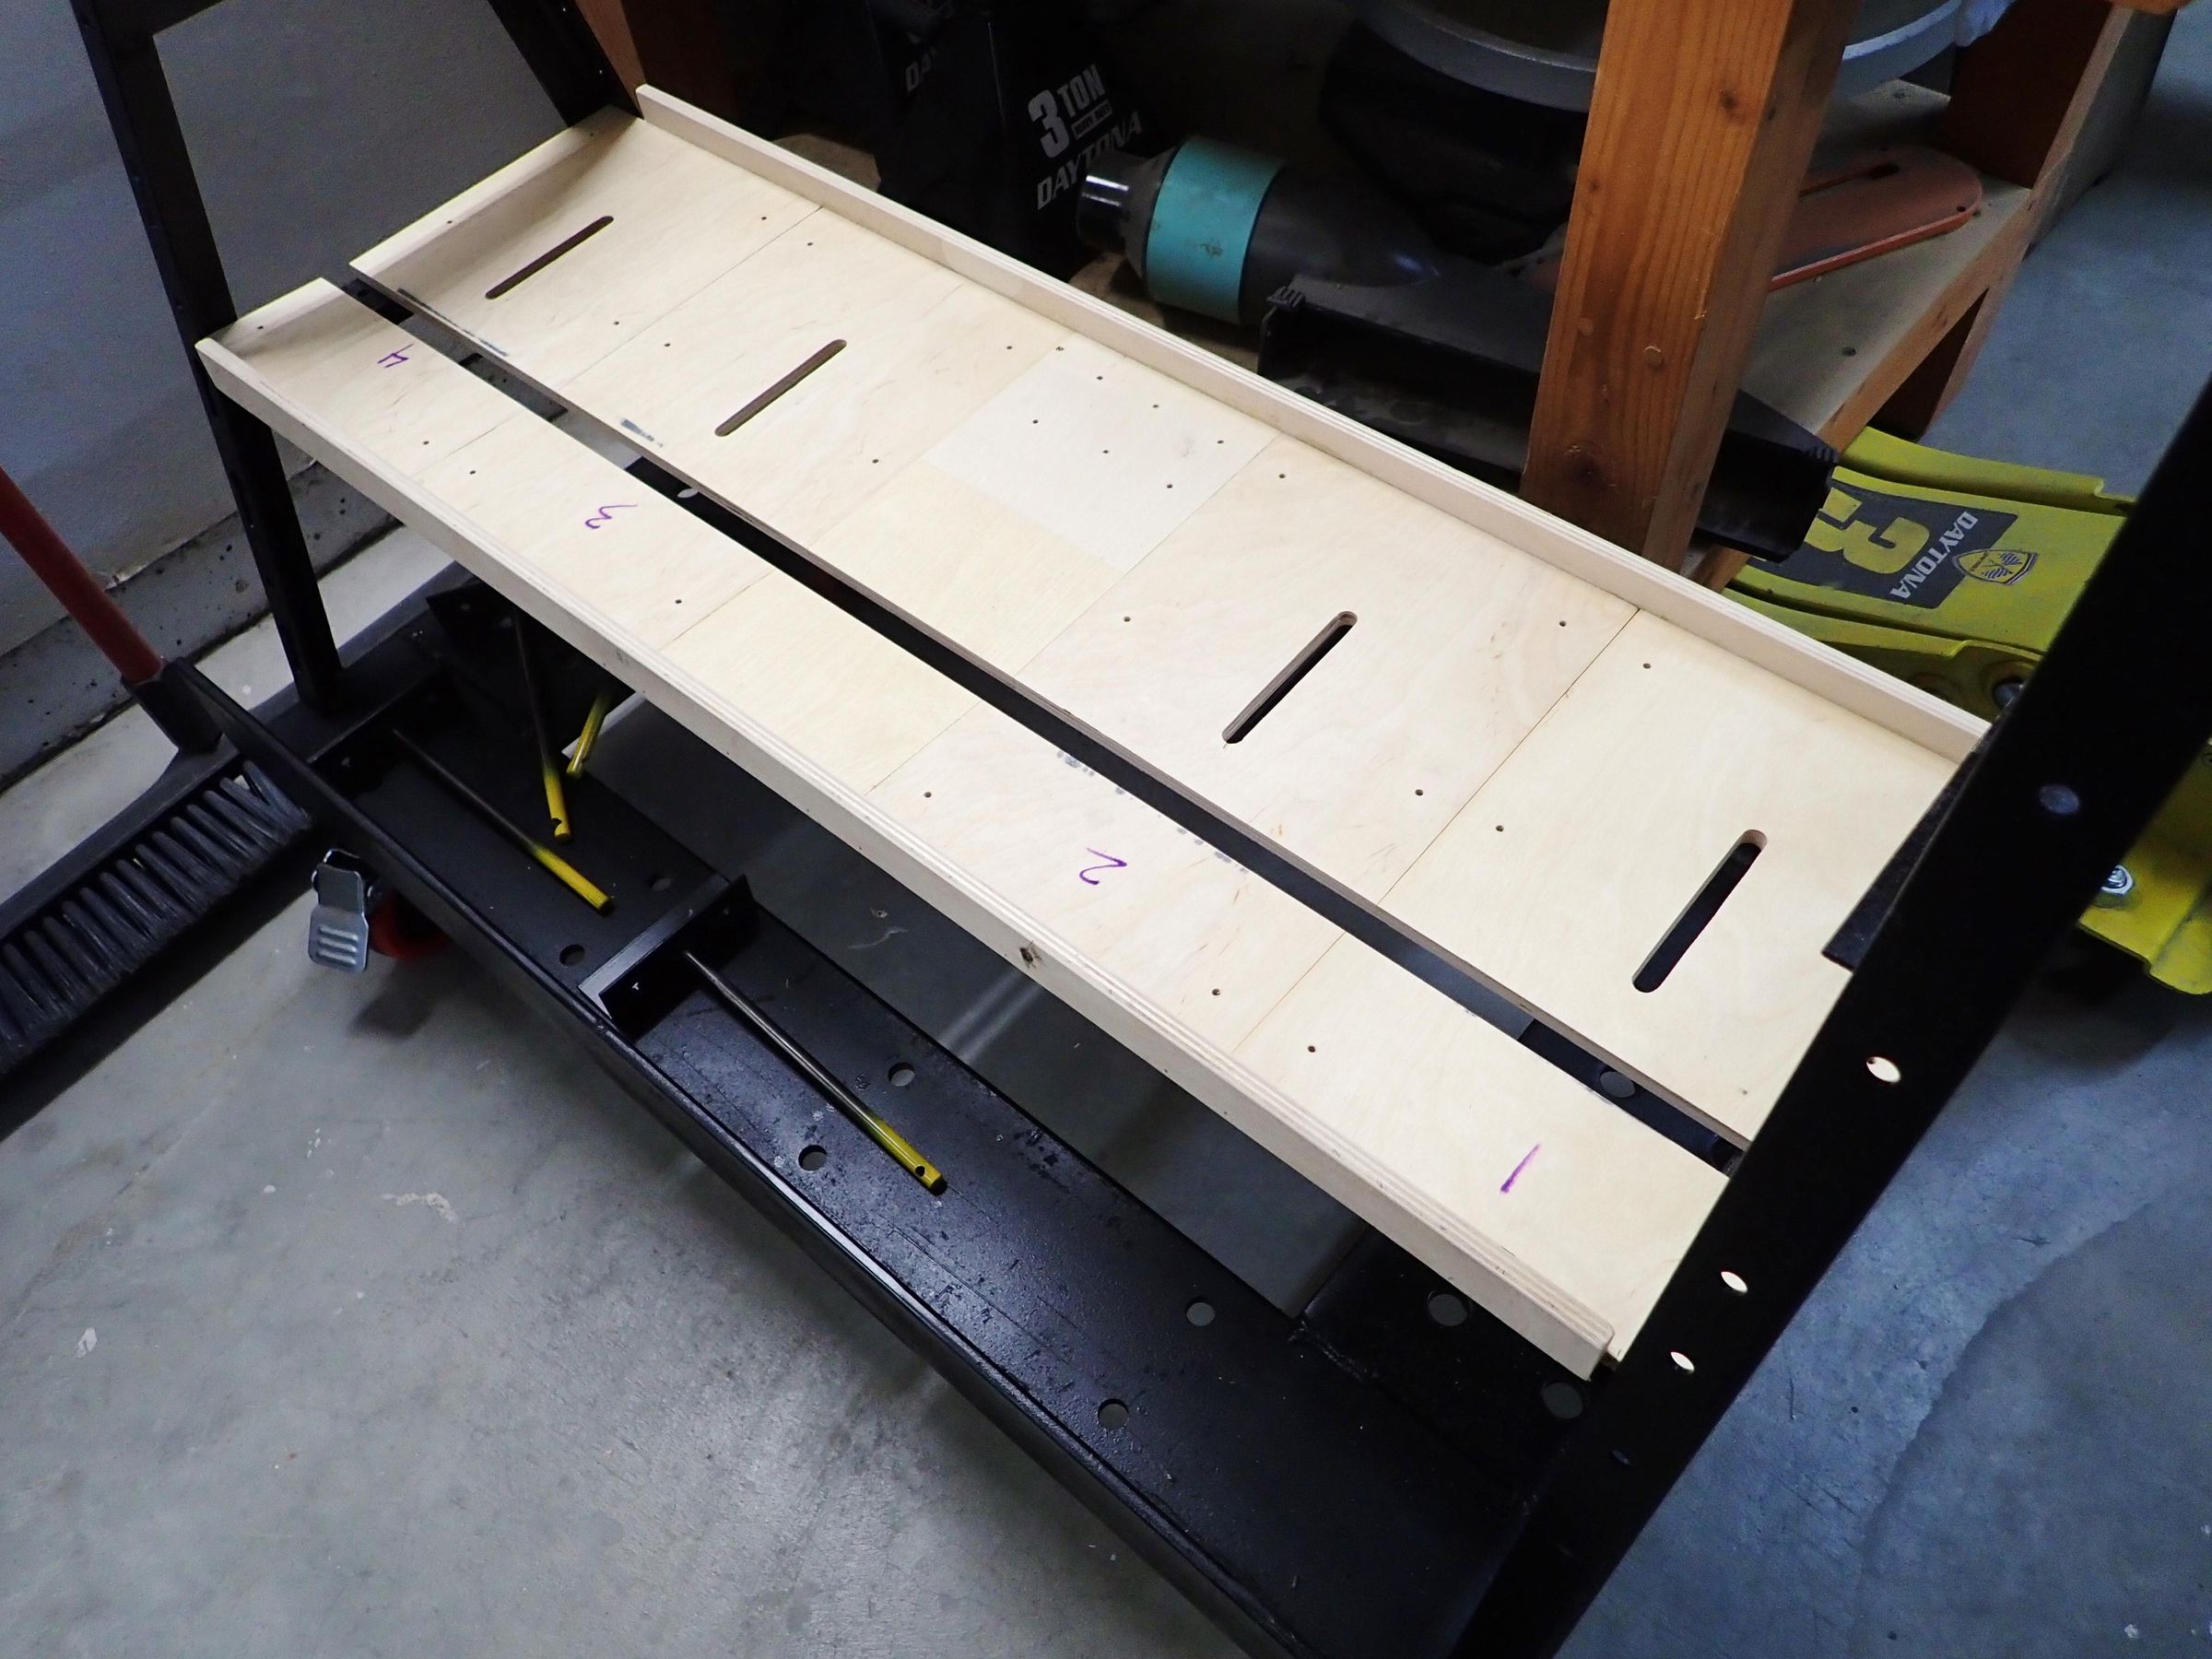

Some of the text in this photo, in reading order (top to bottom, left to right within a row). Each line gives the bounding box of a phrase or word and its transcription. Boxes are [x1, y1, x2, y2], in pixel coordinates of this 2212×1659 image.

[1028, 89, 1070, 159] 3
[1057, 64, 1106, 118] TON
[377, 343, 415, 369] 4
[584, 503, 639, 529] 3
[1804, 488, 1930, 574] 3
[1890, 512, 1979, 599] DAYTONA
[1079, 847, 1127, 885] 2
